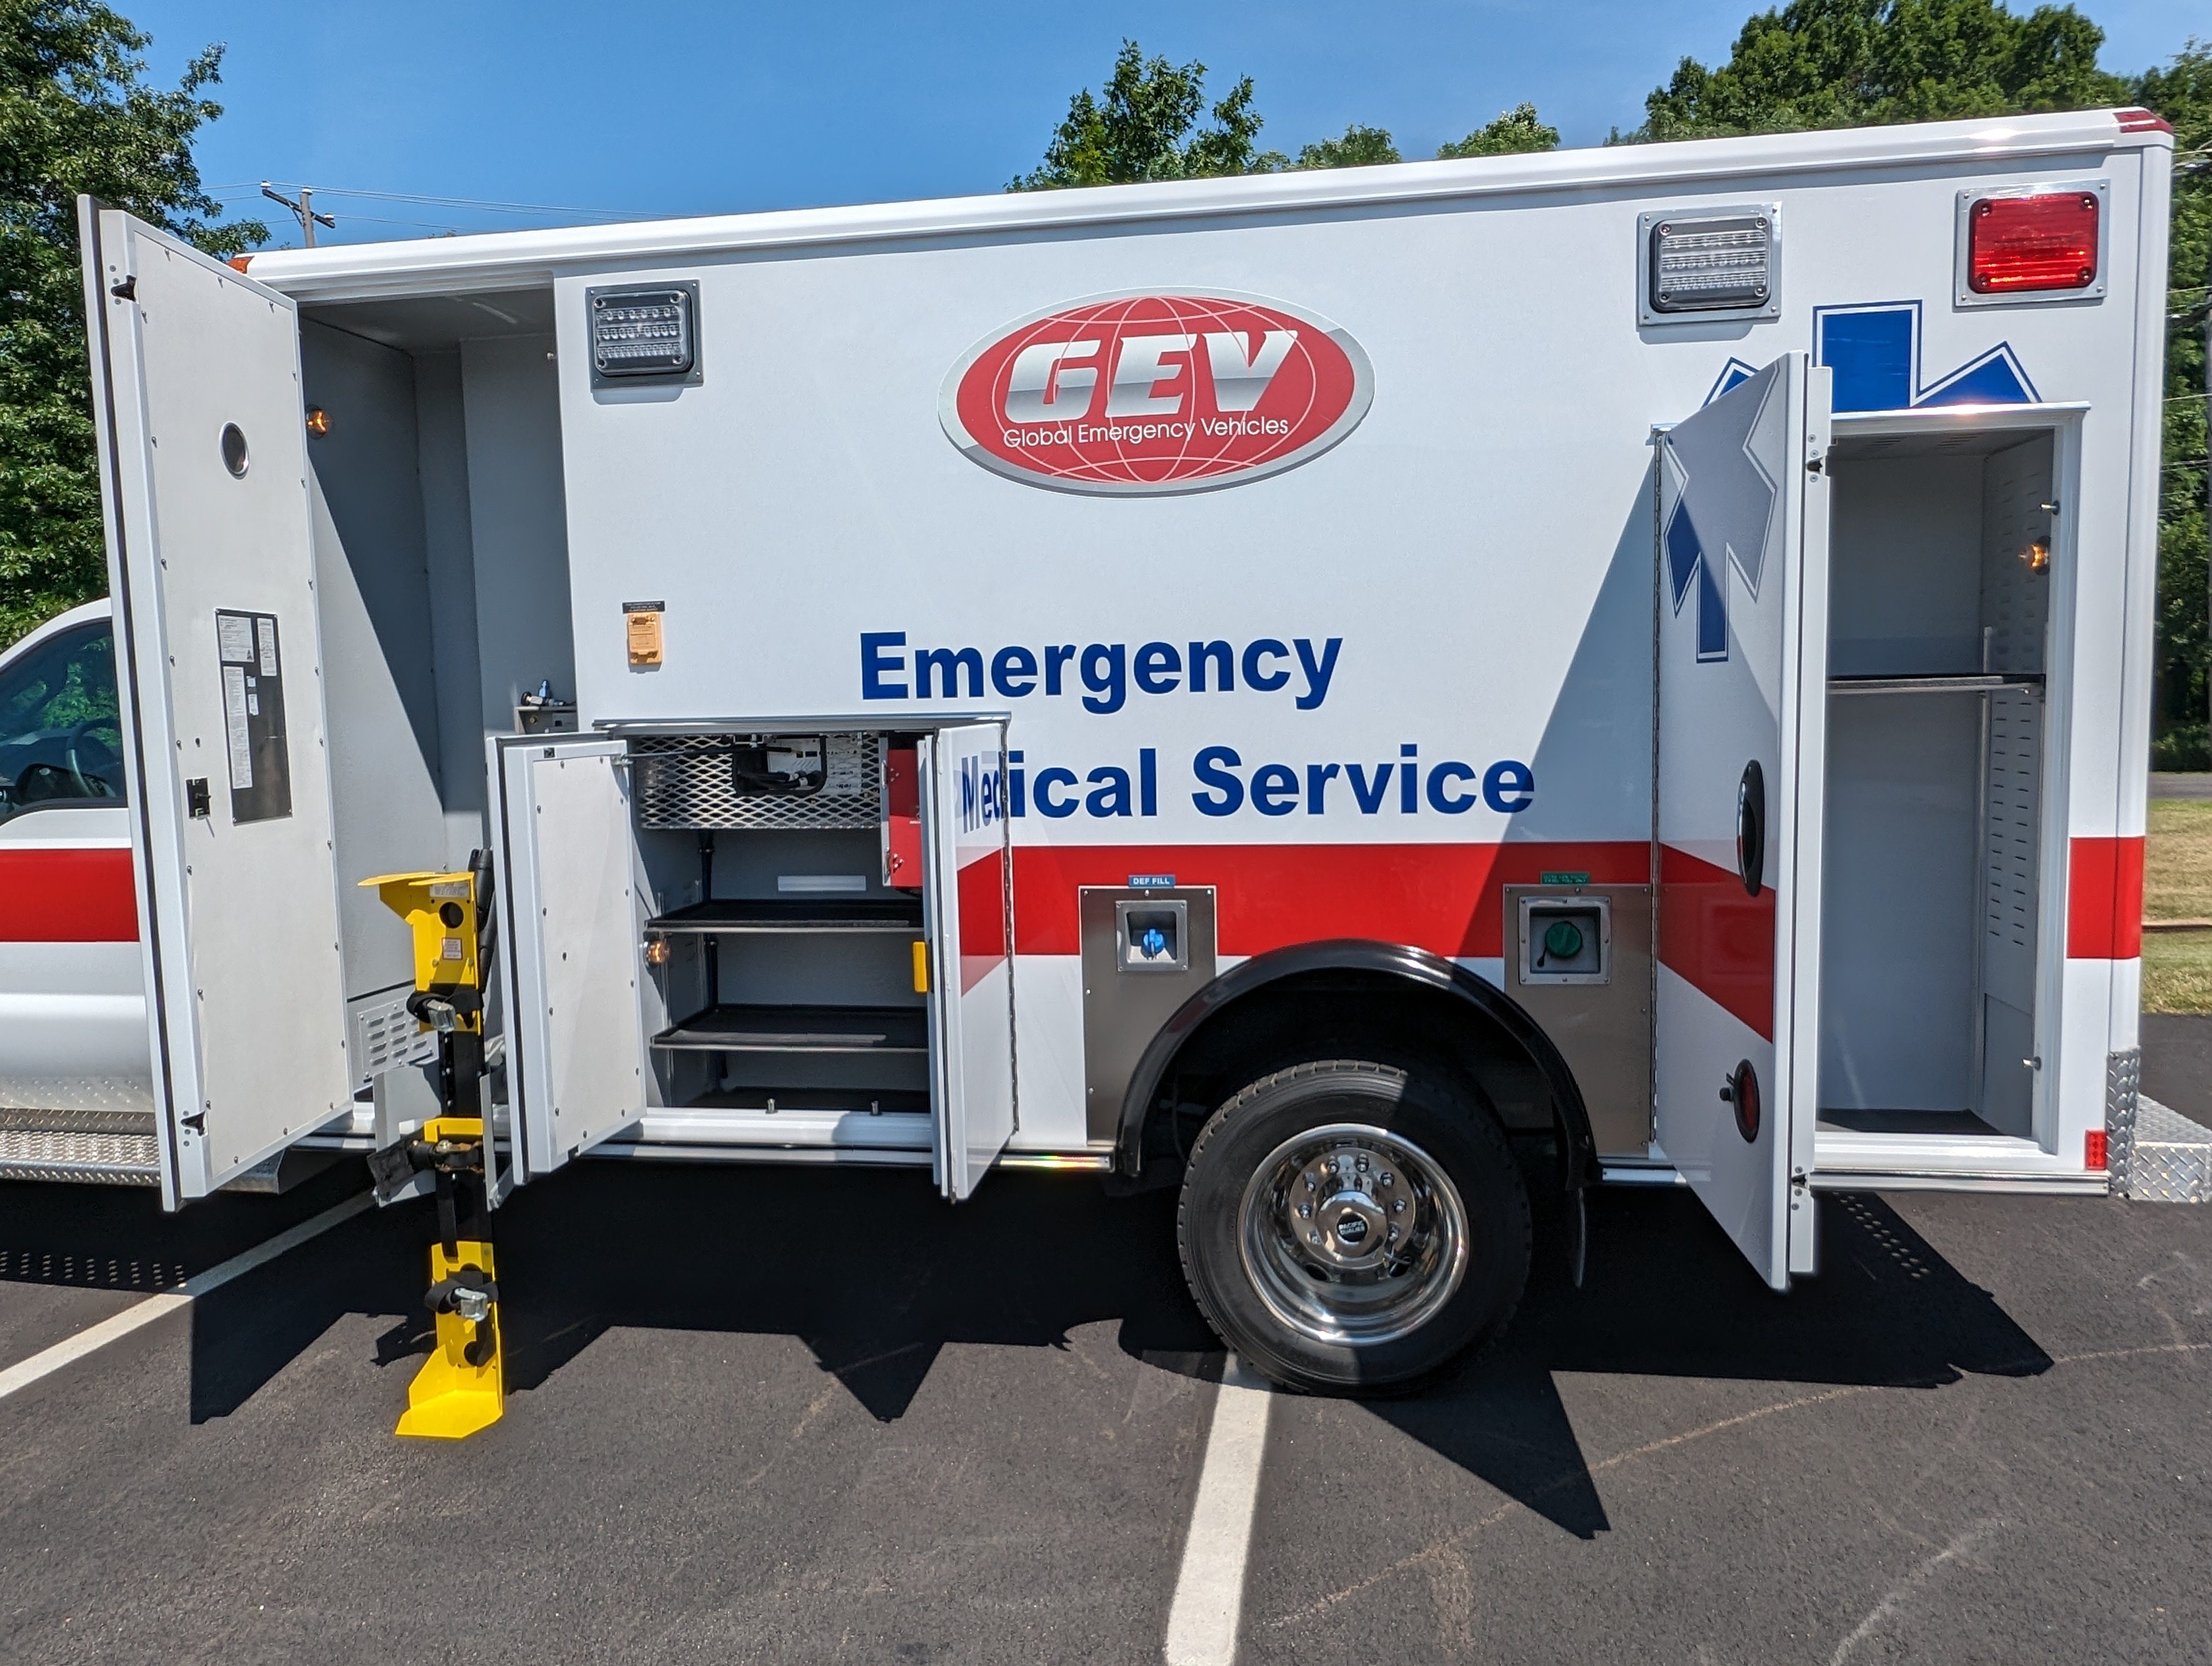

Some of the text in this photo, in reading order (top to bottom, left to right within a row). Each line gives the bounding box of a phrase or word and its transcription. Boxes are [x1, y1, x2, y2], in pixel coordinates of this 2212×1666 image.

[1005, 330, 1298, 423] GEV
[1004, 416, 1289, 447] Global Emergency Vehicles
[860, 631, 1343, 714] Emergency
[961, 744, 1535, 834] Medical Service
[1133, 877, 1170, 885] DEF FILL
